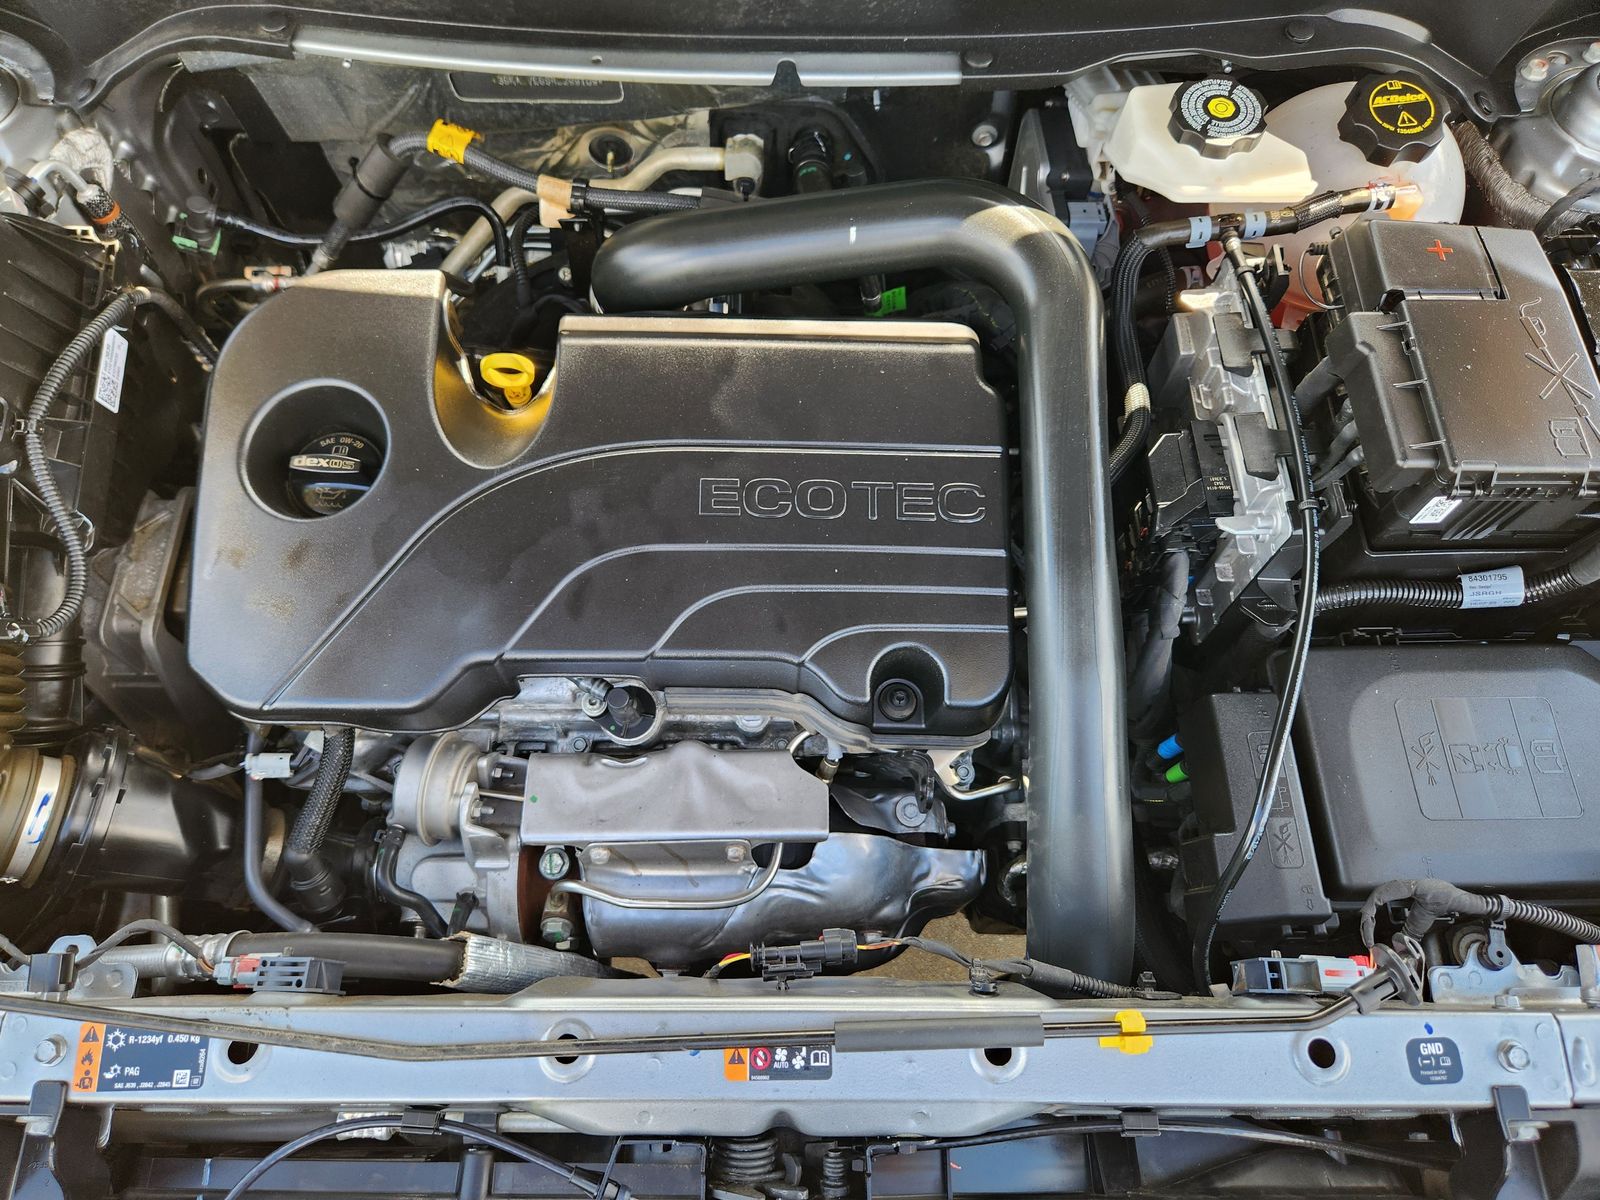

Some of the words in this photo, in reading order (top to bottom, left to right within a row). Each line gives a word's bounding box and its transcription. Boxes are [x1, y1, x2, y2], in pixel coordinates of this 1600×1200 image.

[1373, 93, 1426, 105] ACDelco
[320, 437, 336, 447] SAE
[340, 436, 365, 449] 0W-20
[293, 455, 356, 470] dexos
[698, 477, 986, 524] ECOTEC
[1468, 573, 1508, 582] 84301795
[128, 1034, 164, 1045] R-1234yf
[167, 1034, 189, 1044] 0.450
[1420, 1042, 1444, 1055] GND
[773, 1061, 789, 1069] AUTO
[124, 1066, 140, 1077] PAG
